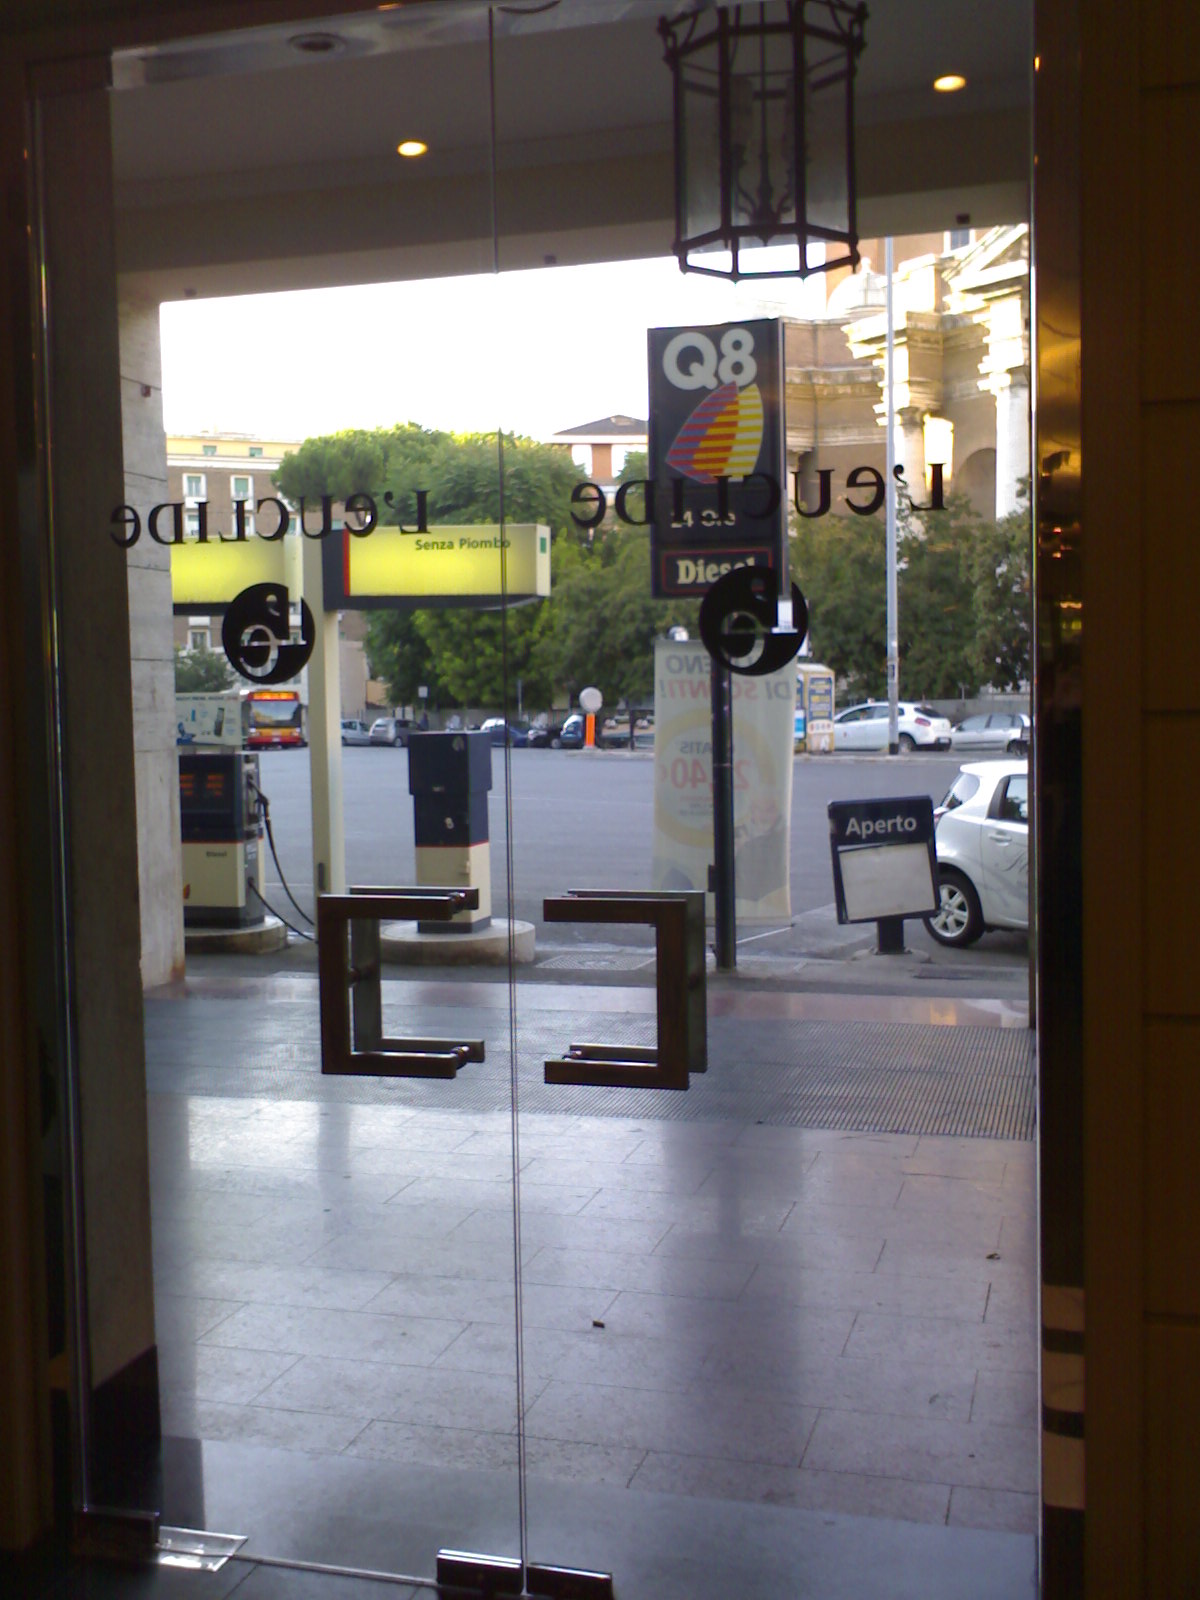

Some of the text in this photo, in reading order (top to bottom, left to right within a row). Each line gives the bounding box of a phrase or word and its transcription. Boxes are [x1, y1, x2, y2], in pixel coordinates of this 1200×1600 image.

[663, 328, 757, 391] Q8
[415, 537, 511, 550] Senza Piombo
[676, 557, 756, 585] Dies
[845, 816, 917, 839] Aperto
